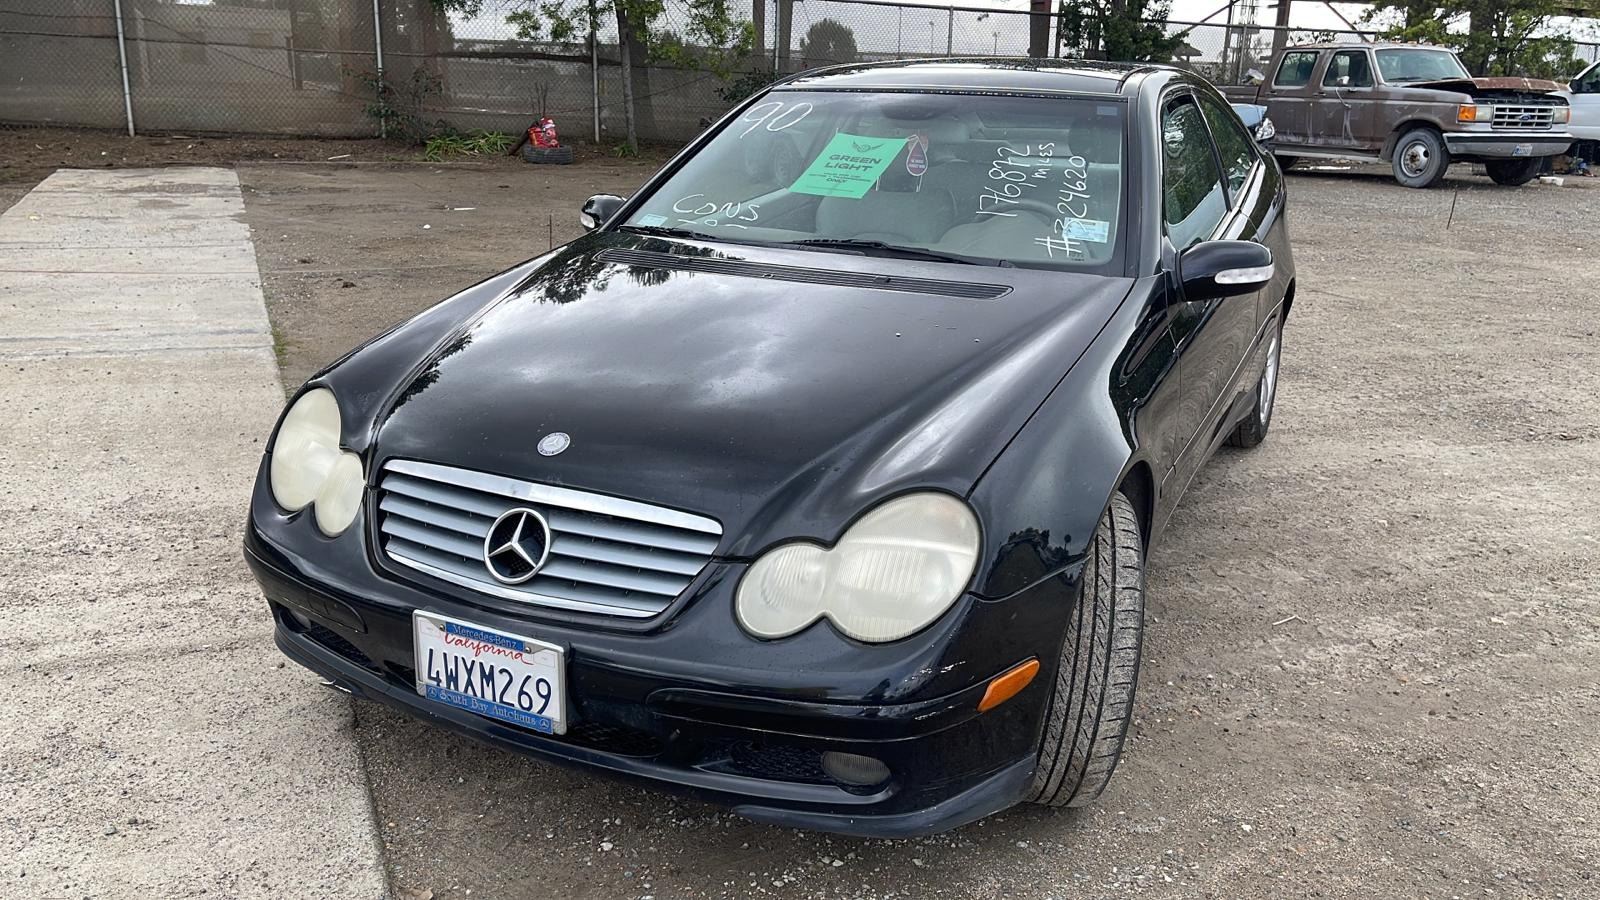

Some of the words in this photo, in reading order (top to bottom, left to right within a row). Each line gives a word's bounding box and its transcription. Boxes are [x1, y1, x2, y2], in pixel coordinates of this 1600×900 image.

[740, 101, 813, 139] 90
[824, 162, 873, 171] LIGHT
[829, 154, 882, 164] GREEN
[1033, 155, 1091, 259] #324620
[452, 624, 518, 648] Mercedes-Benz
[427, 648, 551, 715] 4WXM269
[440, 689, 467, 706] South
[471, 698, 489, 713] Bay
